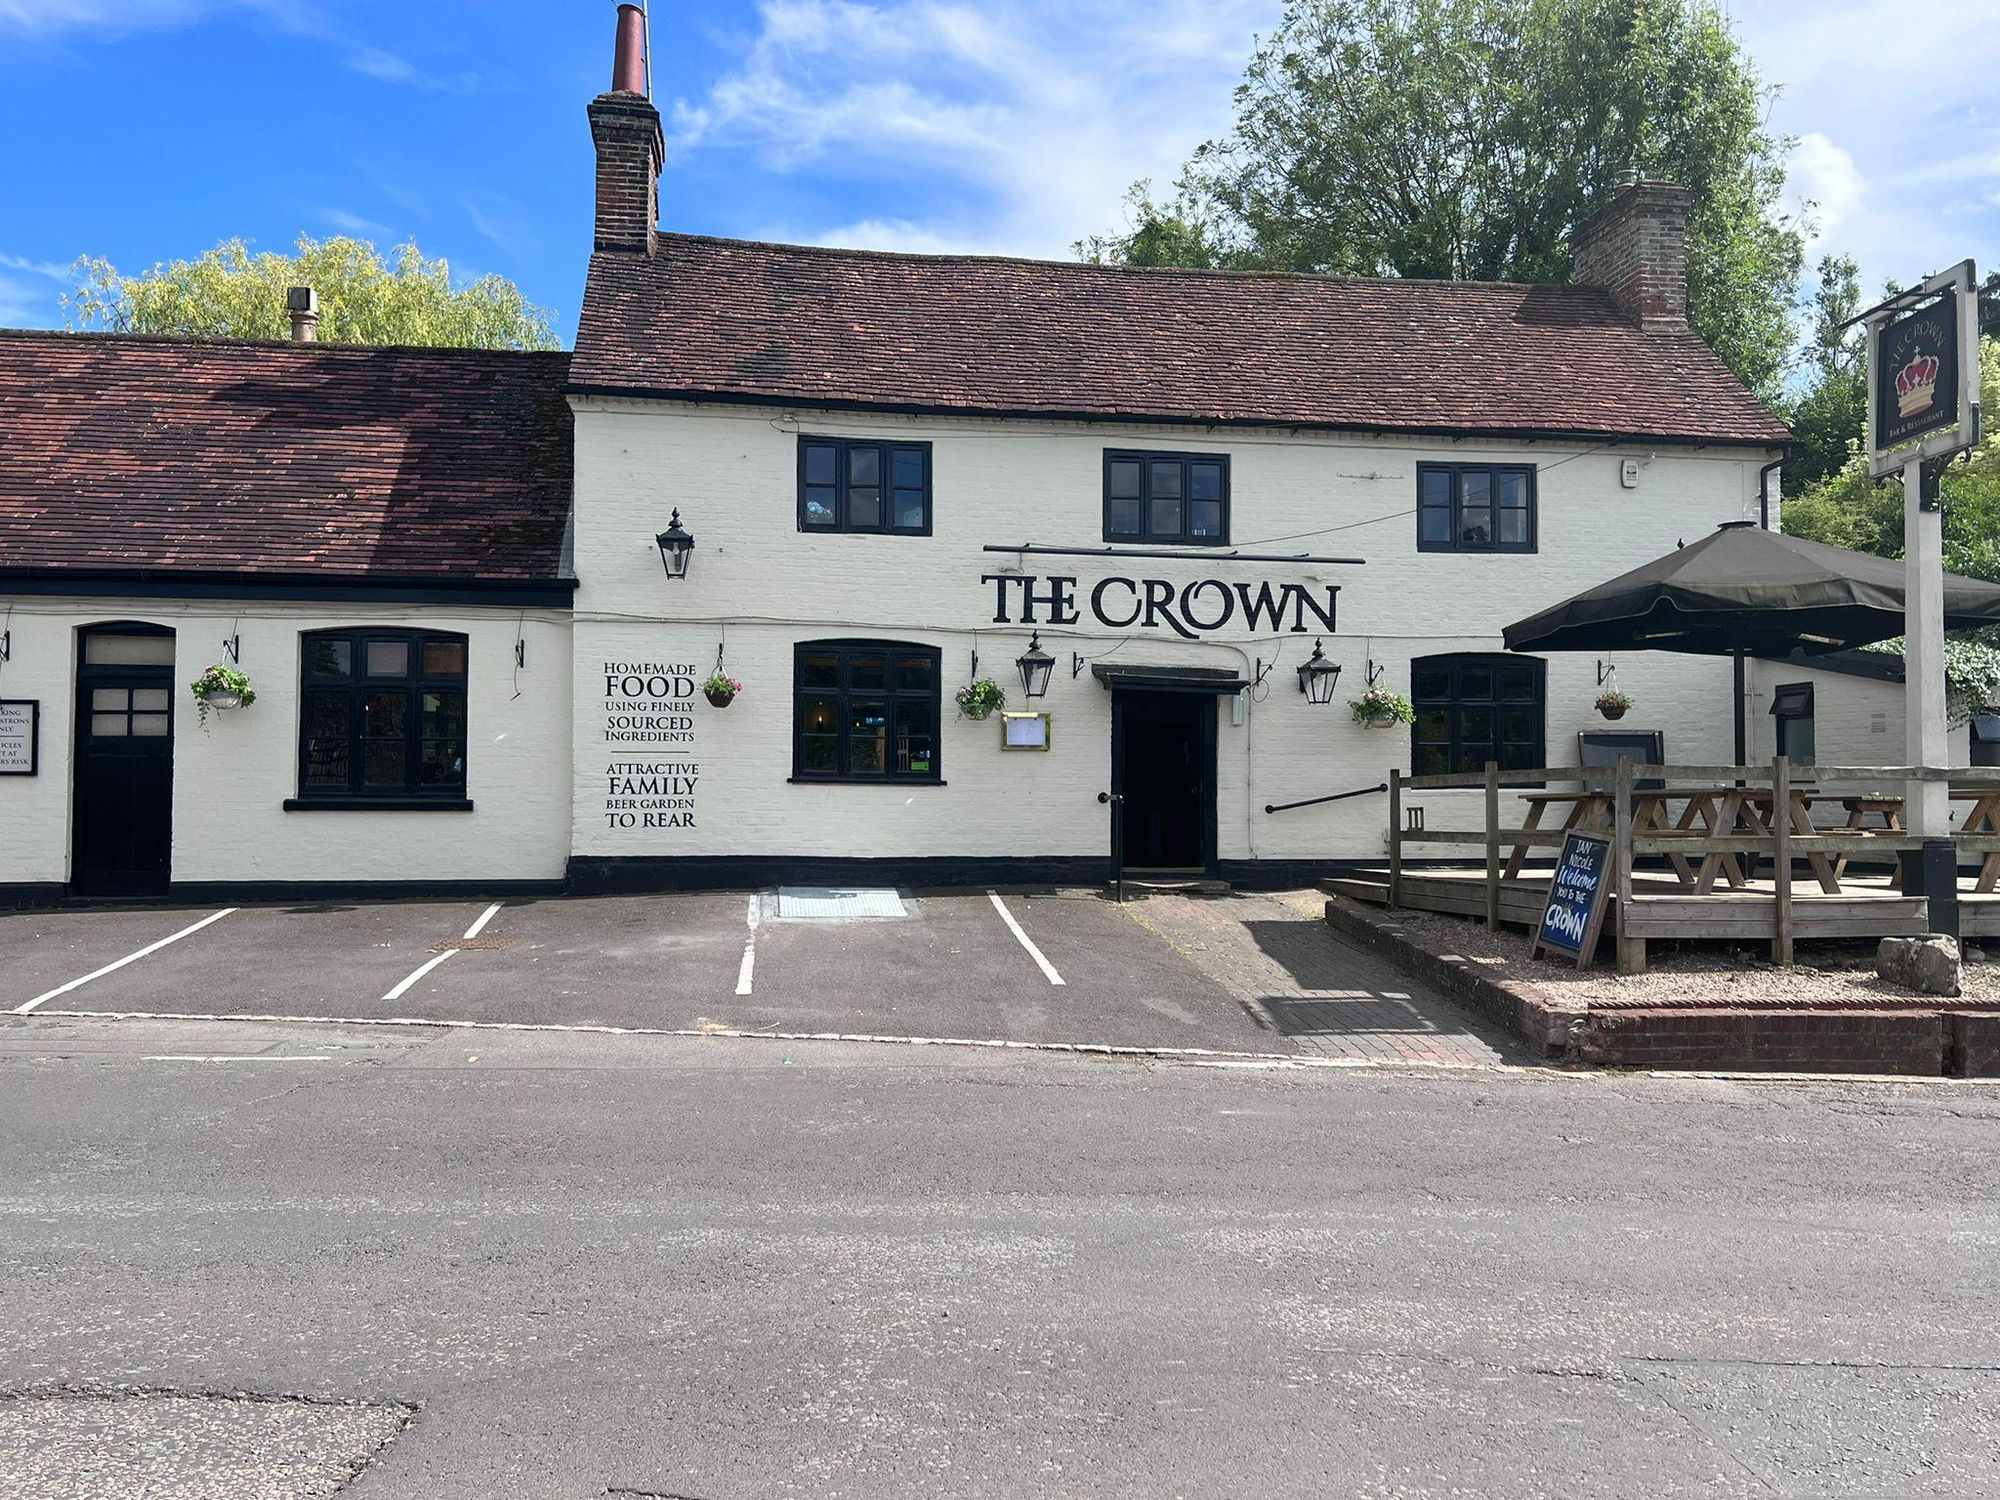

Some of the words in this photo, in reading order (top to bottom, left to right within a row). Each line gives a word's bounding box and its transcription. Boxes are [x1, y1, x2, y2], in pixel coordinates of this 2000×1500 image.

[1904, 320, 1946, 348] CROWN
[981, 575, 1081, 624] THE
[1091, 577, 1341, 639] CROWN
[604, 662, 696, 675] HOMEMADE
[605, 675, 695, 698] FOOD
[605, 701, 647, 711] USING
[651, 702, 694, 712] FINELY
[607, 716, 693, 730] SOURCED
[605, 731, 694, 742] INGREDIENTS
[606, 763, 699, 775] ATTRACTIVE
[608, 777, 699, 795] FAMILY
[606, 800, 636, 809] BEER
[640, 799, 694, 809] GARDEN
[605, 812, 636, 828] TO
[643, 812, 697, 828] REAR
[1557, 865, 1597, 891] Welcome
[1545, 903, 1588, 943] CROWN
